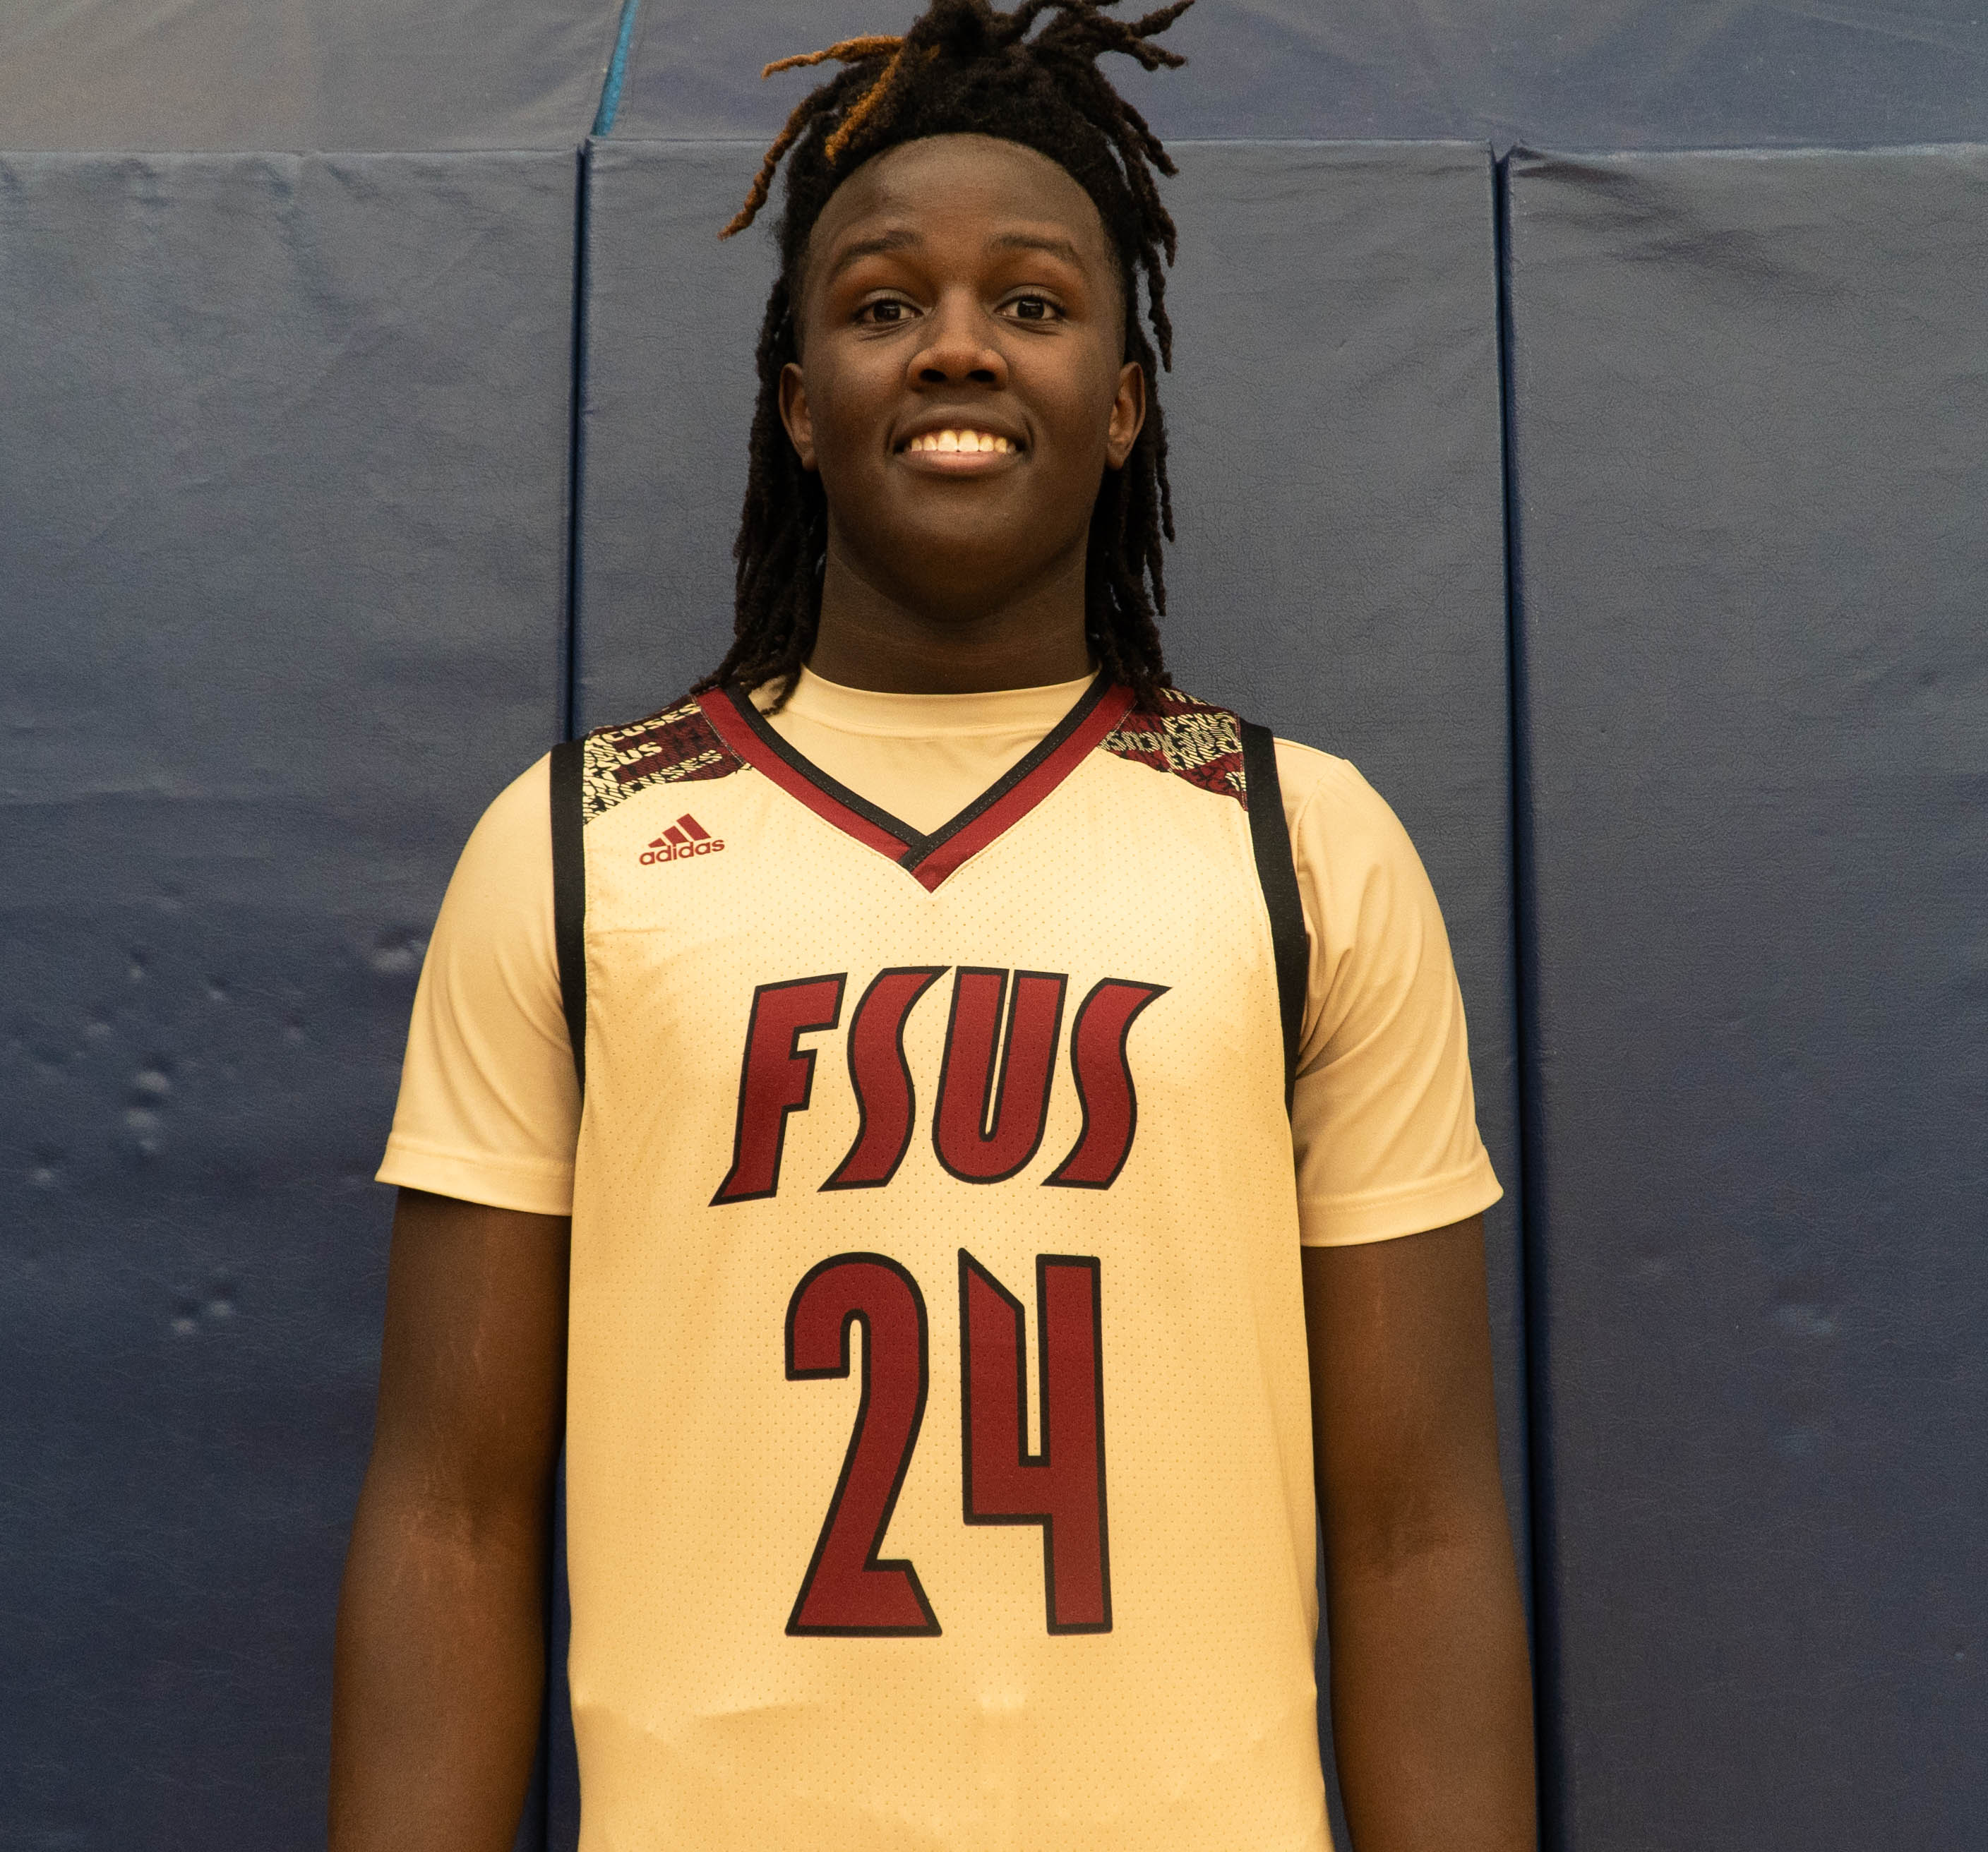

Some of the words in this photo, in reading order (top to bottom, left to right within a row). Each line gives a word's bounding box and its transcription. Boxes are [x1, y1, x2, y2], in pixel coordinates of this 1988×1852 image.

[638, 839, 726, 866] adidas
[707, 965, 1173, 1208] FSUS
[784, 1247, 1113, 1639] 24
